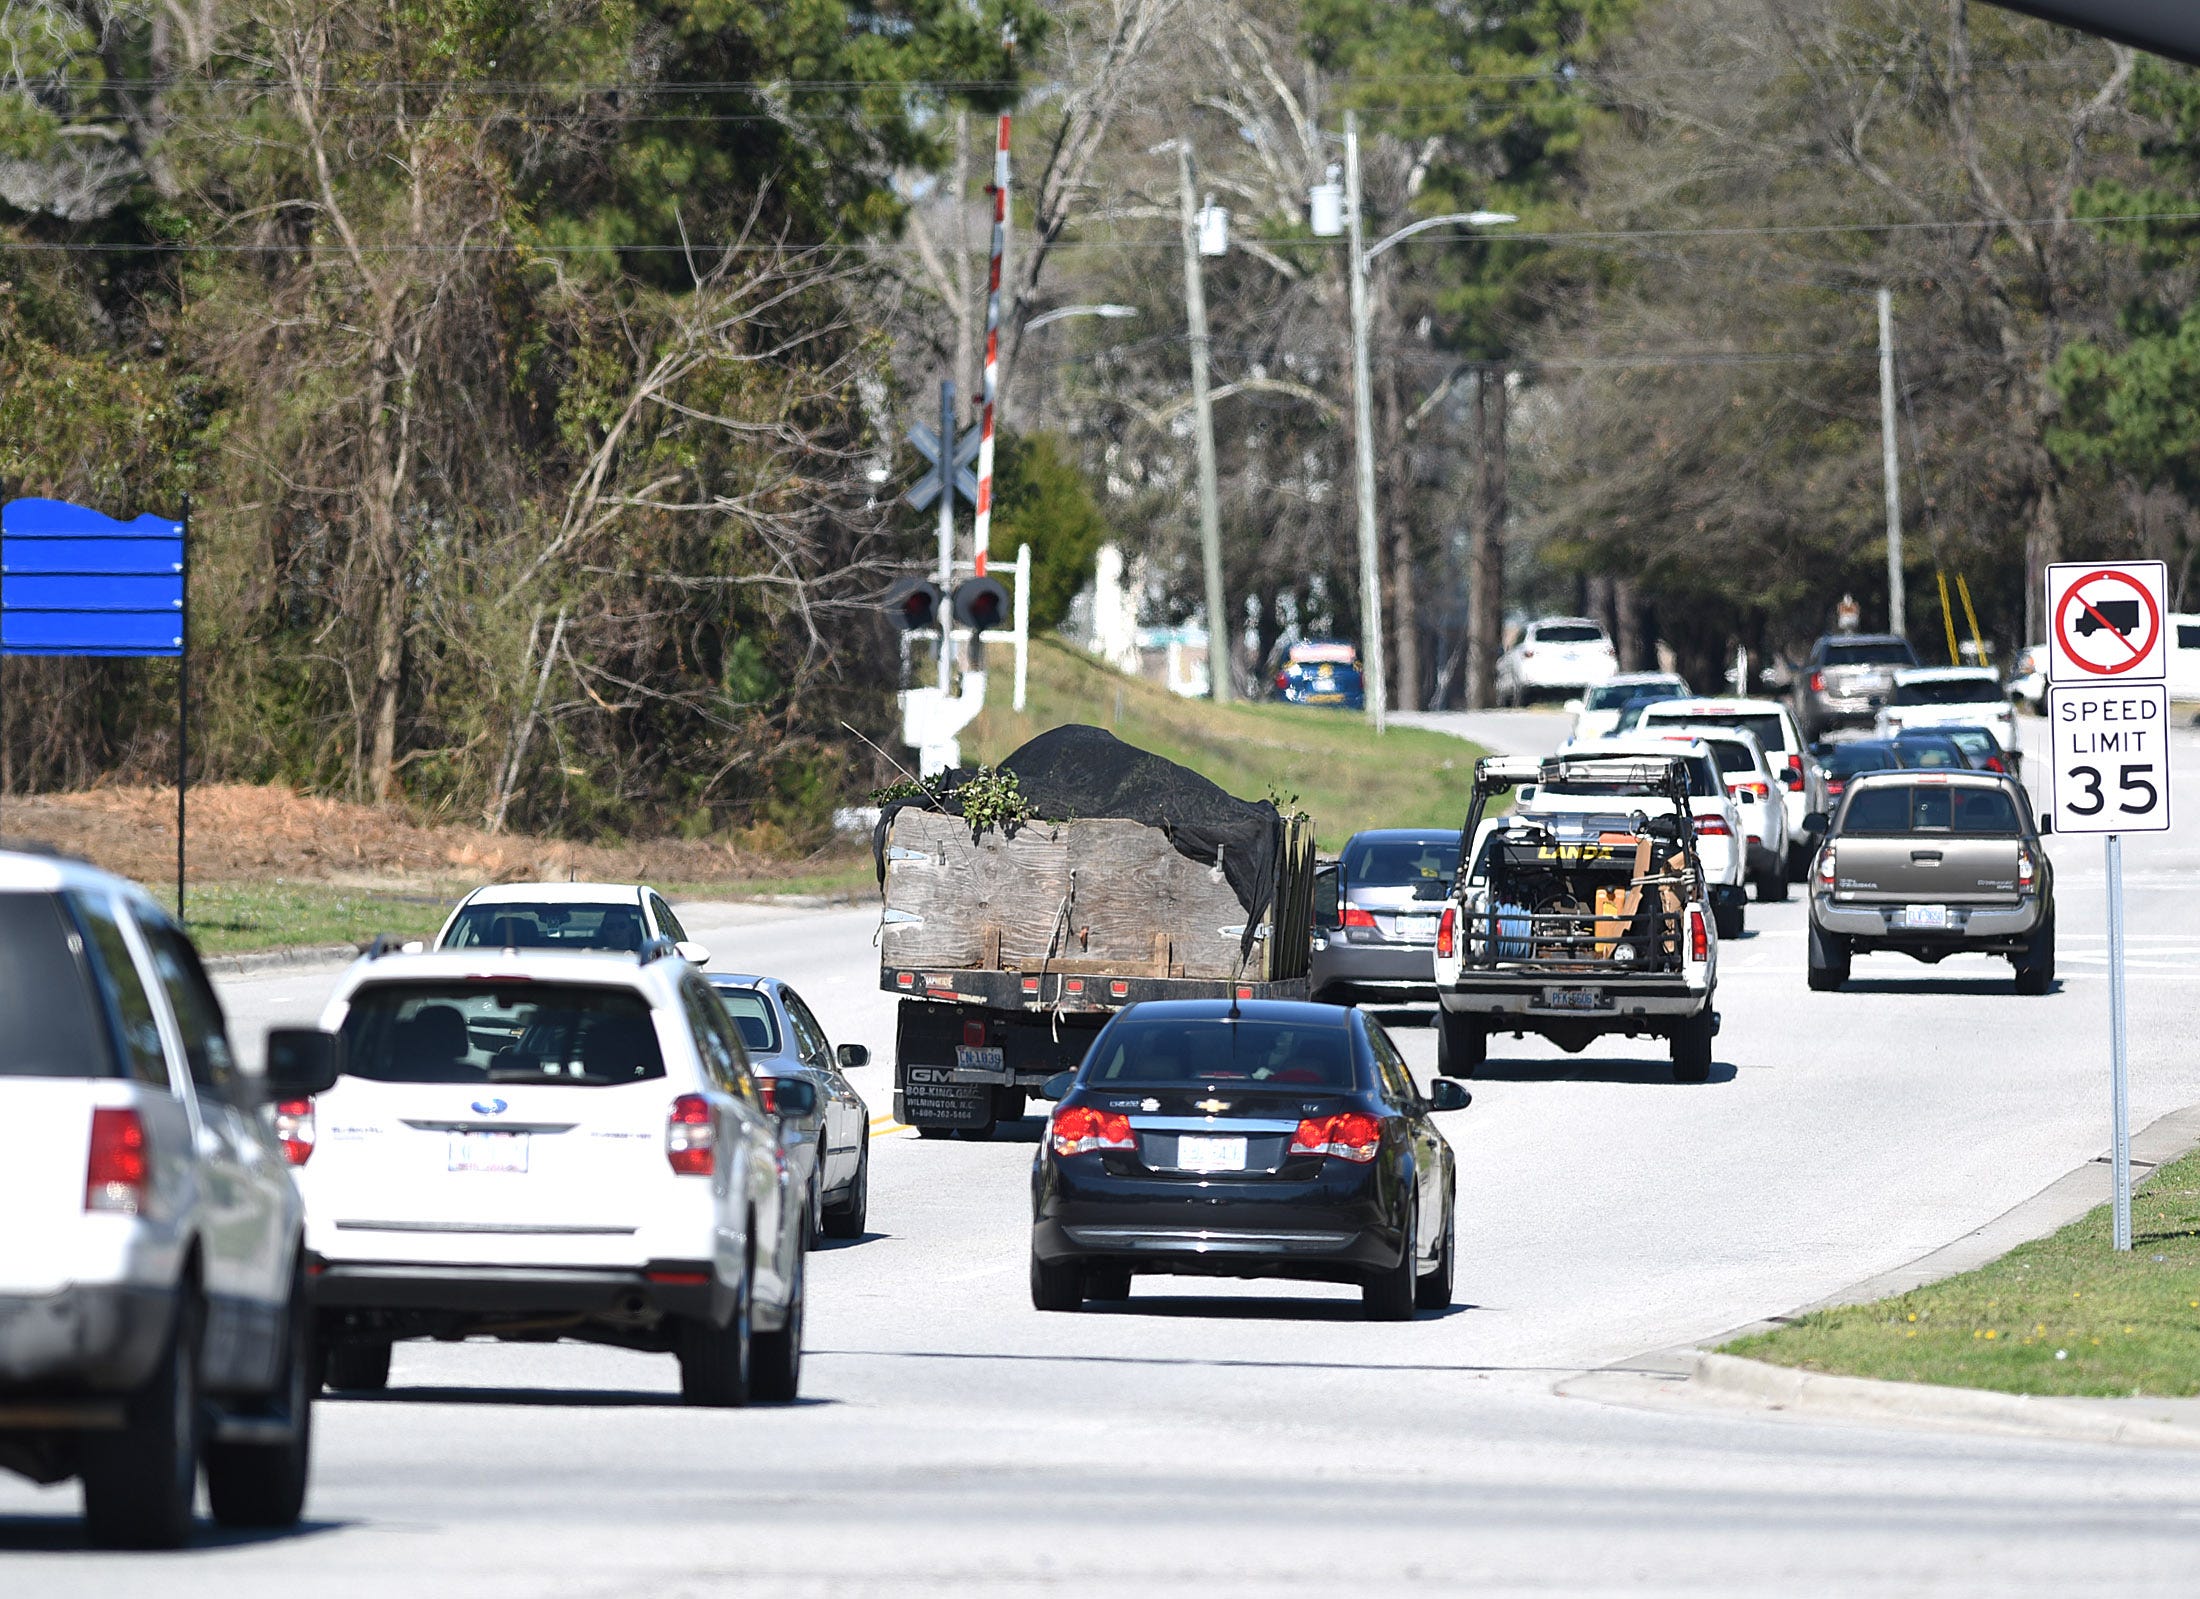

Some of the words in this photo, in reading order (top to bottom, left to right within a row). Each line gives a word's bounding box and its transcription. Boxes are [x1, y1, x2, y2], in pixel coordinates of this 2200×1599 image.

[2062, 699, 2157, 722] SPEED
[2073, 731, 2147, 754] LIMIT
[2066, 763, 2158, 816] 35
[911, 1068, 954, 1083] GM
